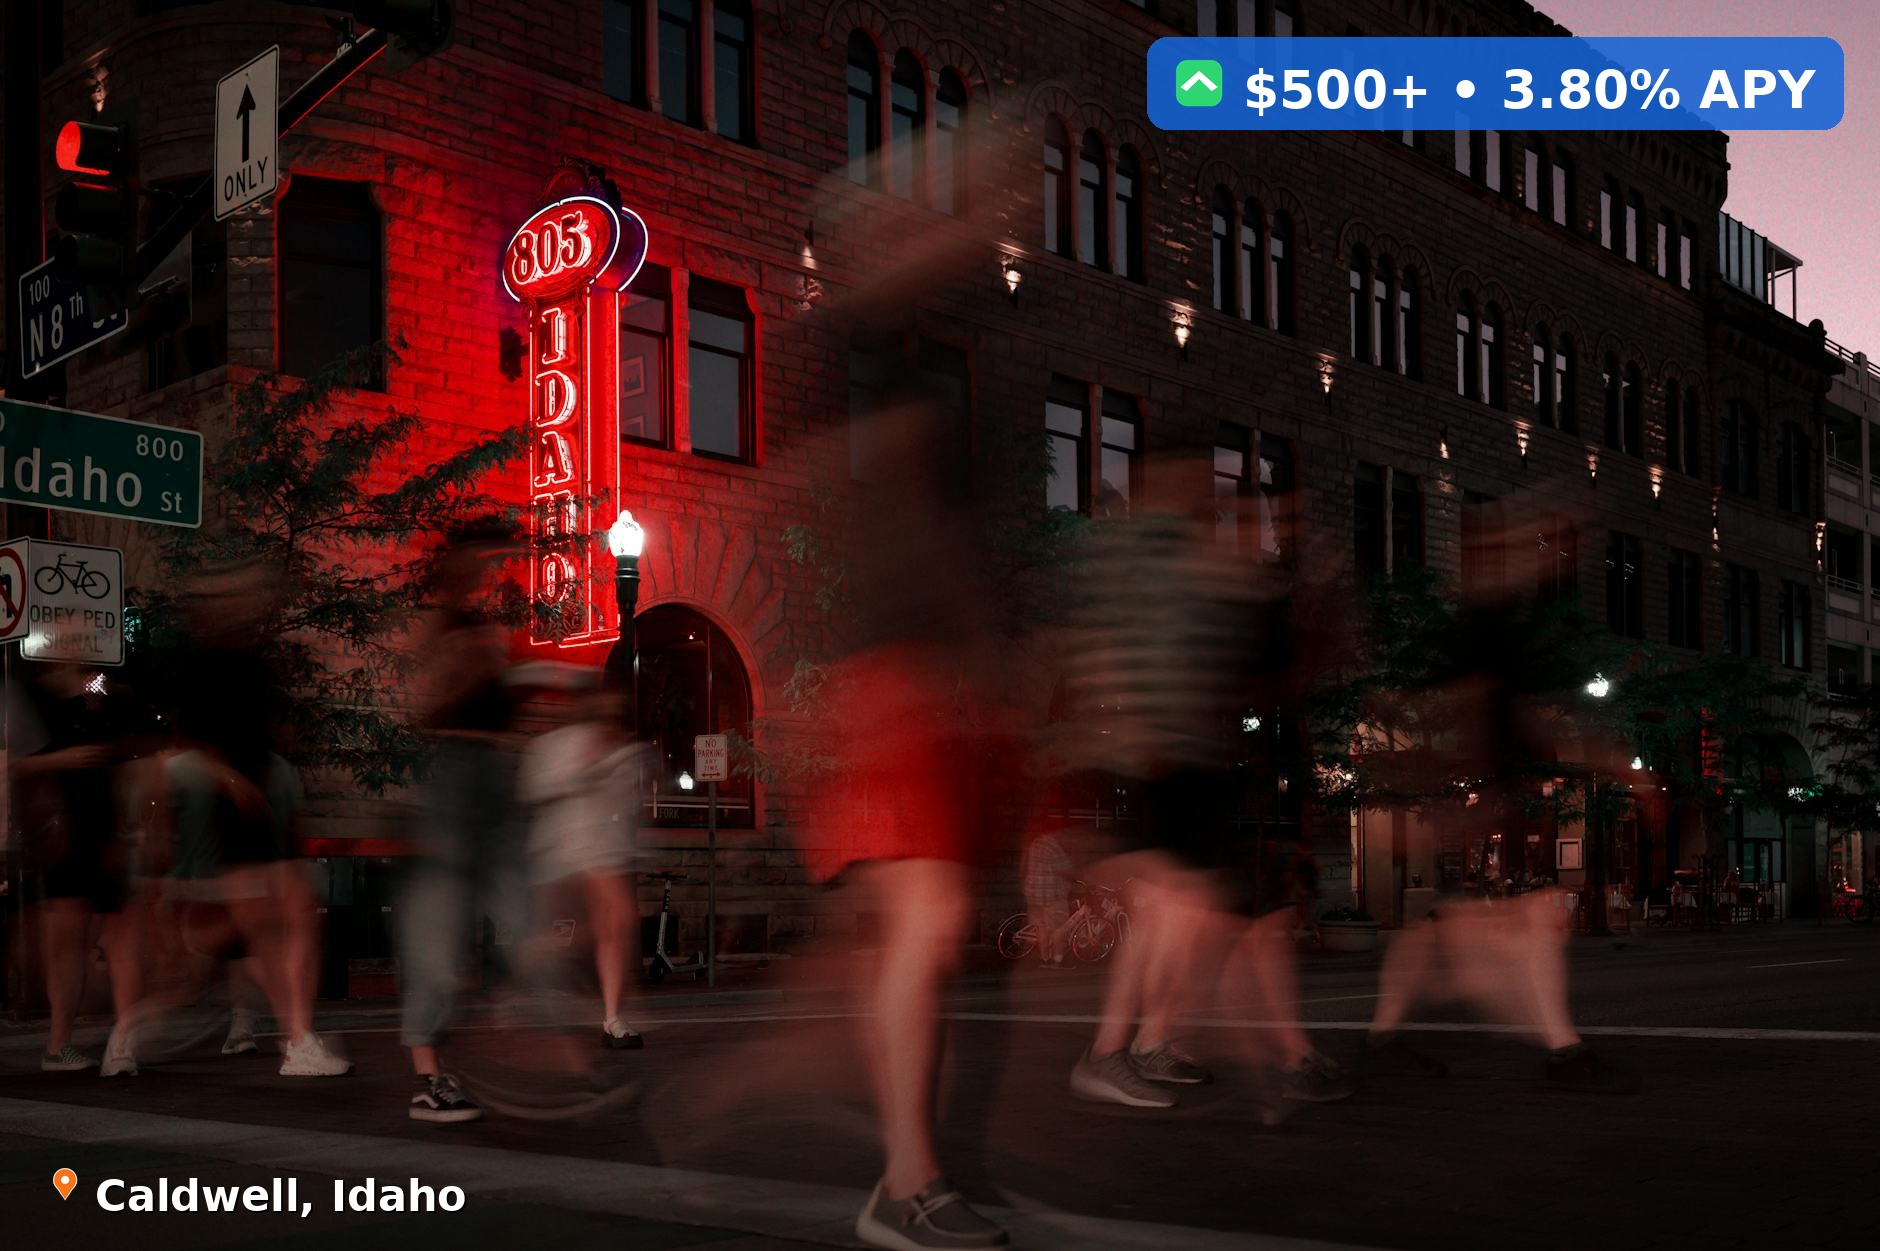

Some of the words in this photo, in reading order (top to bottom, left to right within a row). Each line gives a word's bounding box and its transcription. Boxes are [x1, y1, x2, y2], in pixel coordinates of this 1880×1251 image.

[224, 155, 268, 202] ONLY
[511, 210, 592, 285] 805
[29, 274, 51, 306] 100
[30, 311, 44, 362] N
[135, 433, 184, 463] 800
[30, 604, 76, 625] OBEY
[83, 609, 116, 630] PED
[697, 749, 725, 758] PARKING
[705, 739, 717, 748] NO
